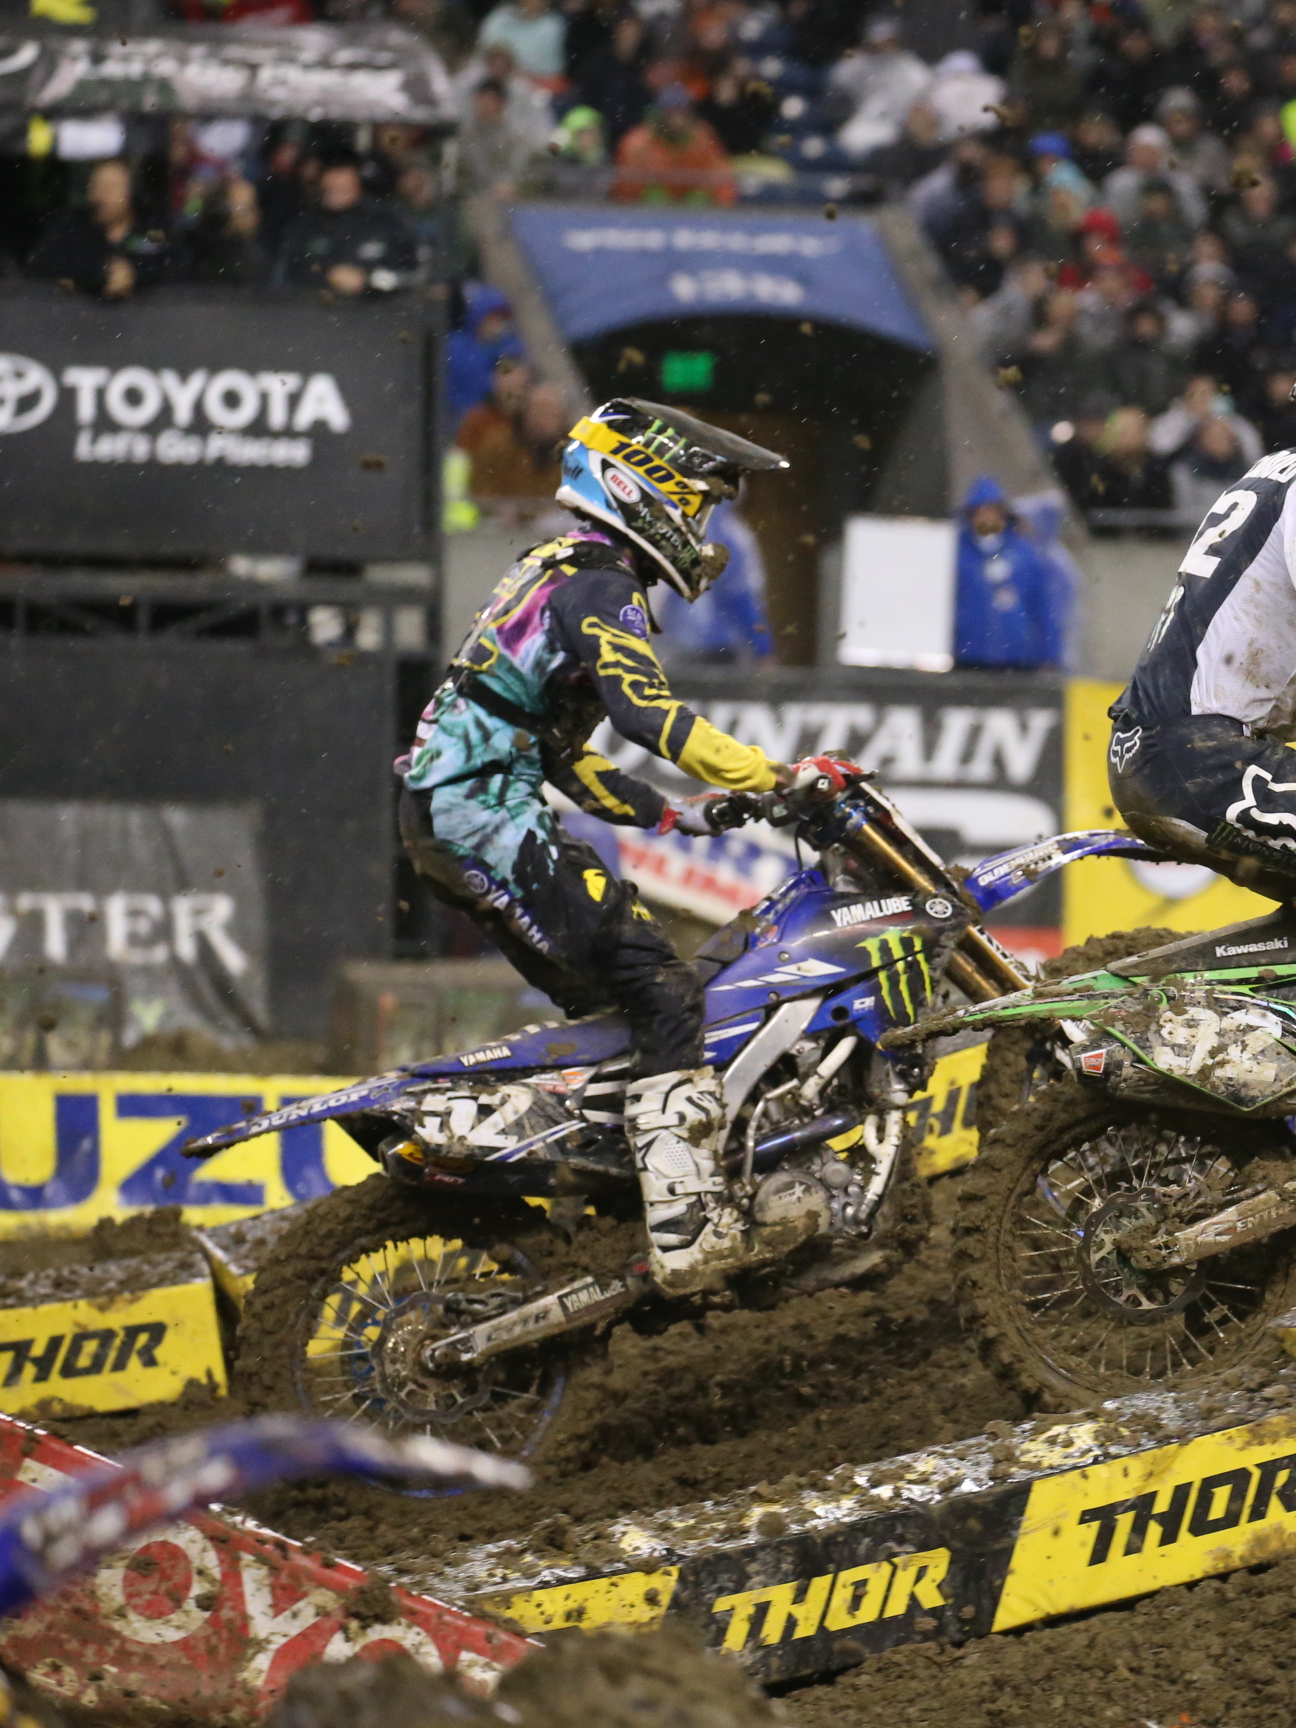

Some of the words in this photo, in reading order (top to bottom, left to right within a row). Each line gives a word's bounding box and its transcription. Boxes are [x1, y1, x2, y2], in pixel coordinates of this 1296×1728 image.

[62, 365, 351, 434] TOYOTA
[155, 429, 202, 465] Go
[609, 440, 697, 507] 100%
[609, 473, 634, 499] BELL
[1178, 489, 1258, 578] 2
[487, 884, 550, 954] YAMAHA
[830, 896, 913, 928] YAMALUBE
[1215, 937, 1290, 958] Kawasaki
[459, 1046, 512, 1067] YAMAHA
[249, 1088, 370, 1133] DUNLOP
[711, 1547, 952, 1655] THOR
